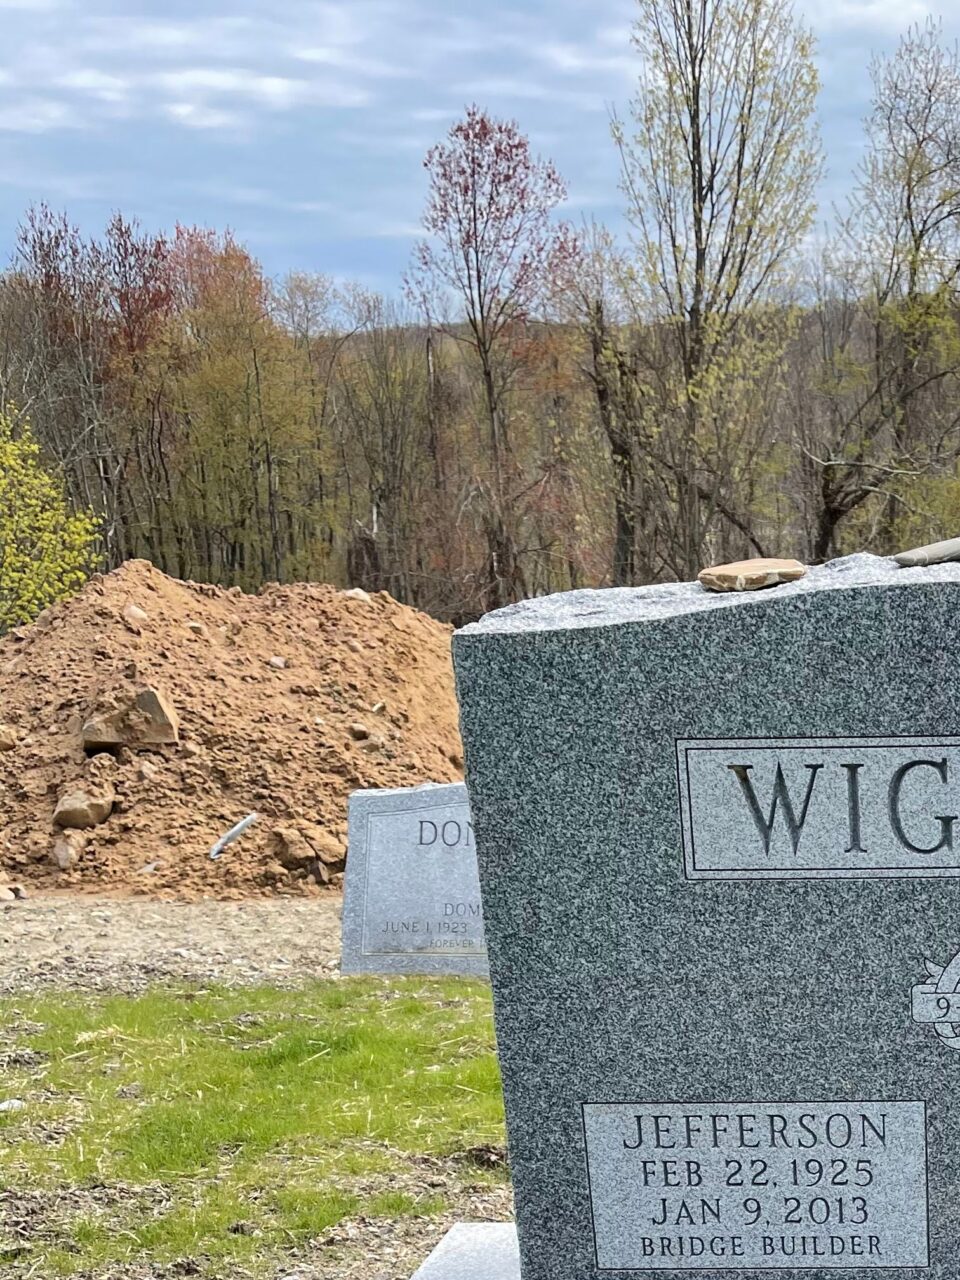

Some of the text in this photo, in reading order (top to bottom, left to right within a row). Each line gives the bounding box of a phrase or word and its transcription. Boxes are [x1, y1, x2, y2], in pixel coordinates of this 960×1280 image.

[382, 921, 419, 934] JUNE
[623, 1113, 887, 1150] JEFFERSON
[641, 1160, 702, 1187] FEB
[652, 1198, 721, 1226] JAN
[641, 1235, 882, 1257] BRIDGE BUILDER
